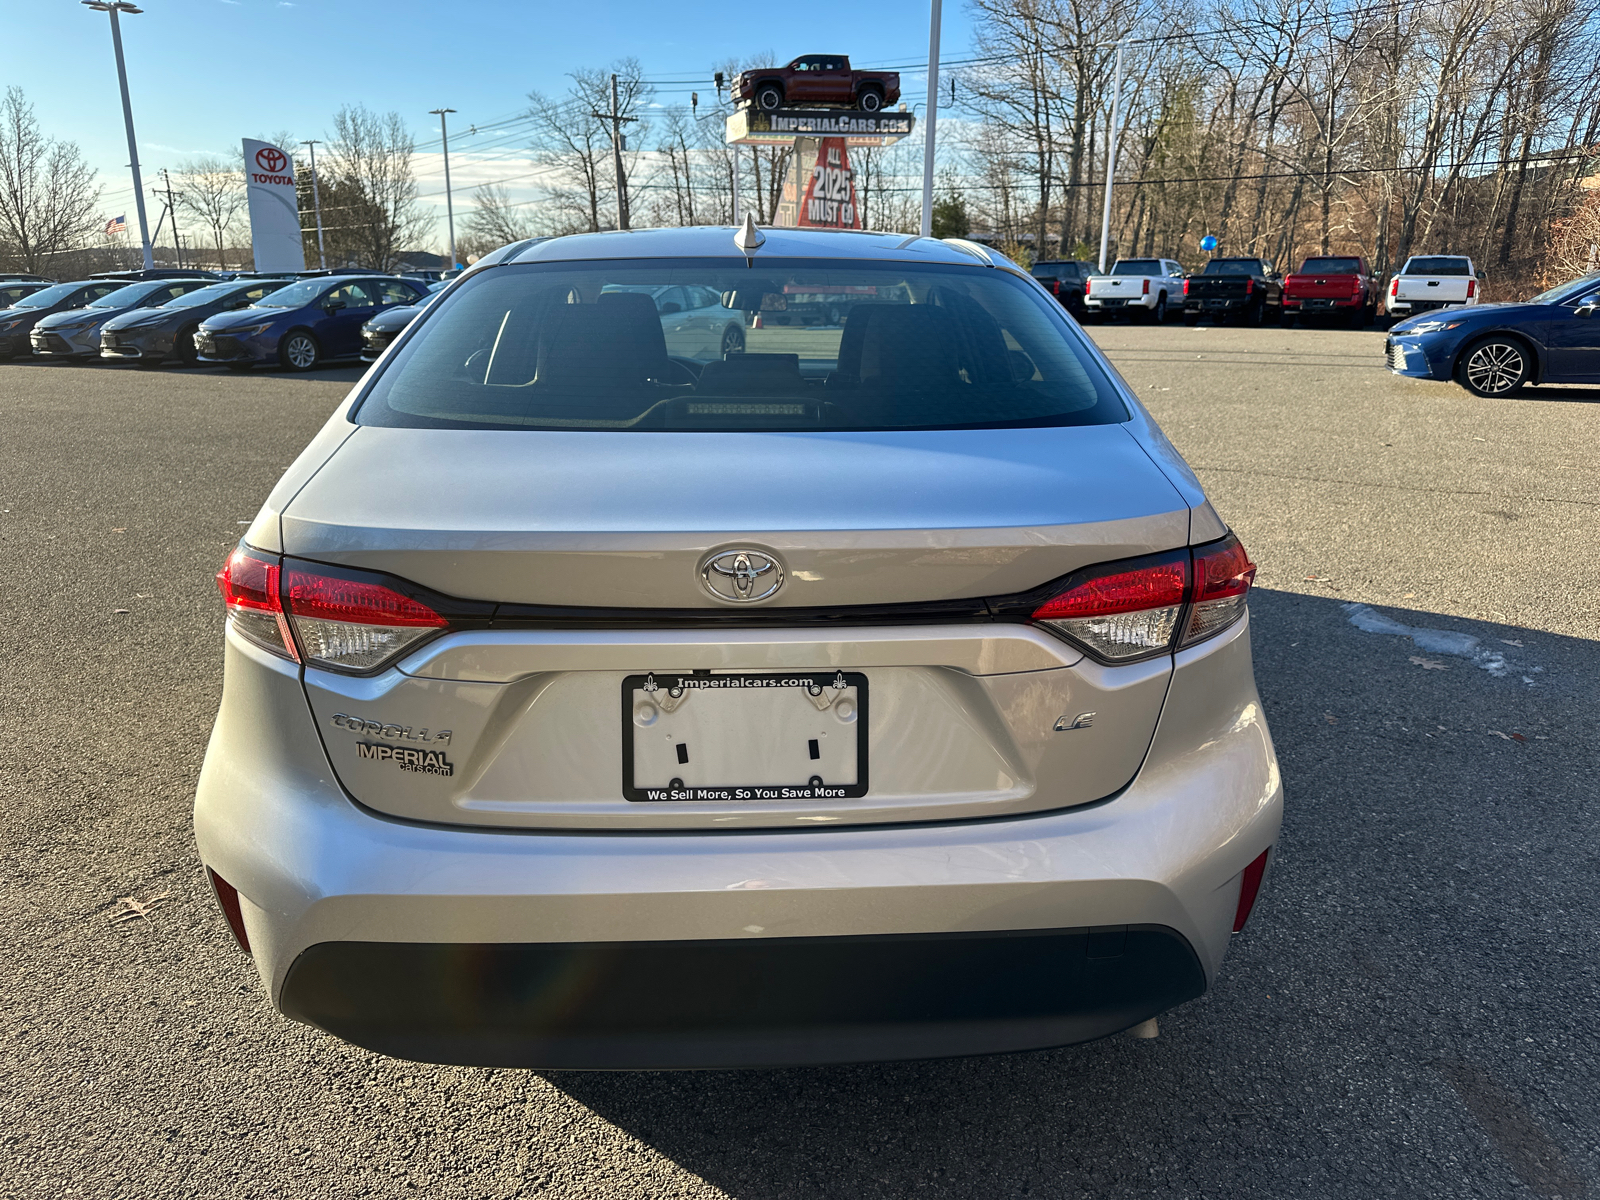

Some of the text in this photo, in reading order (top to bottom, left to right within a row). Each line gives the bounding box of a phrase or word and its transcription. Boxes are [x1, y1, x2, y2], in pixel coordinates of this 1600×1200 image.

[827, 148, 841, 165] ALL
[251, 173, 294, 185] TOYOTA
[813, 166, 850, 201] 2025
[808, 199, 838, 222] MUST
[841, 203, 854, 224] GO
[677, 677, 814, 689] Imperialcars.com
[329, 712, 453, 746] COROLLA
[1053, 711, 1097, 731] LE
[355, 742, 451, 769] IMPERIAL
[398, 762, 451, 776] cars.com
[647, 788, 845, 801] We Sell More, So You Save More
